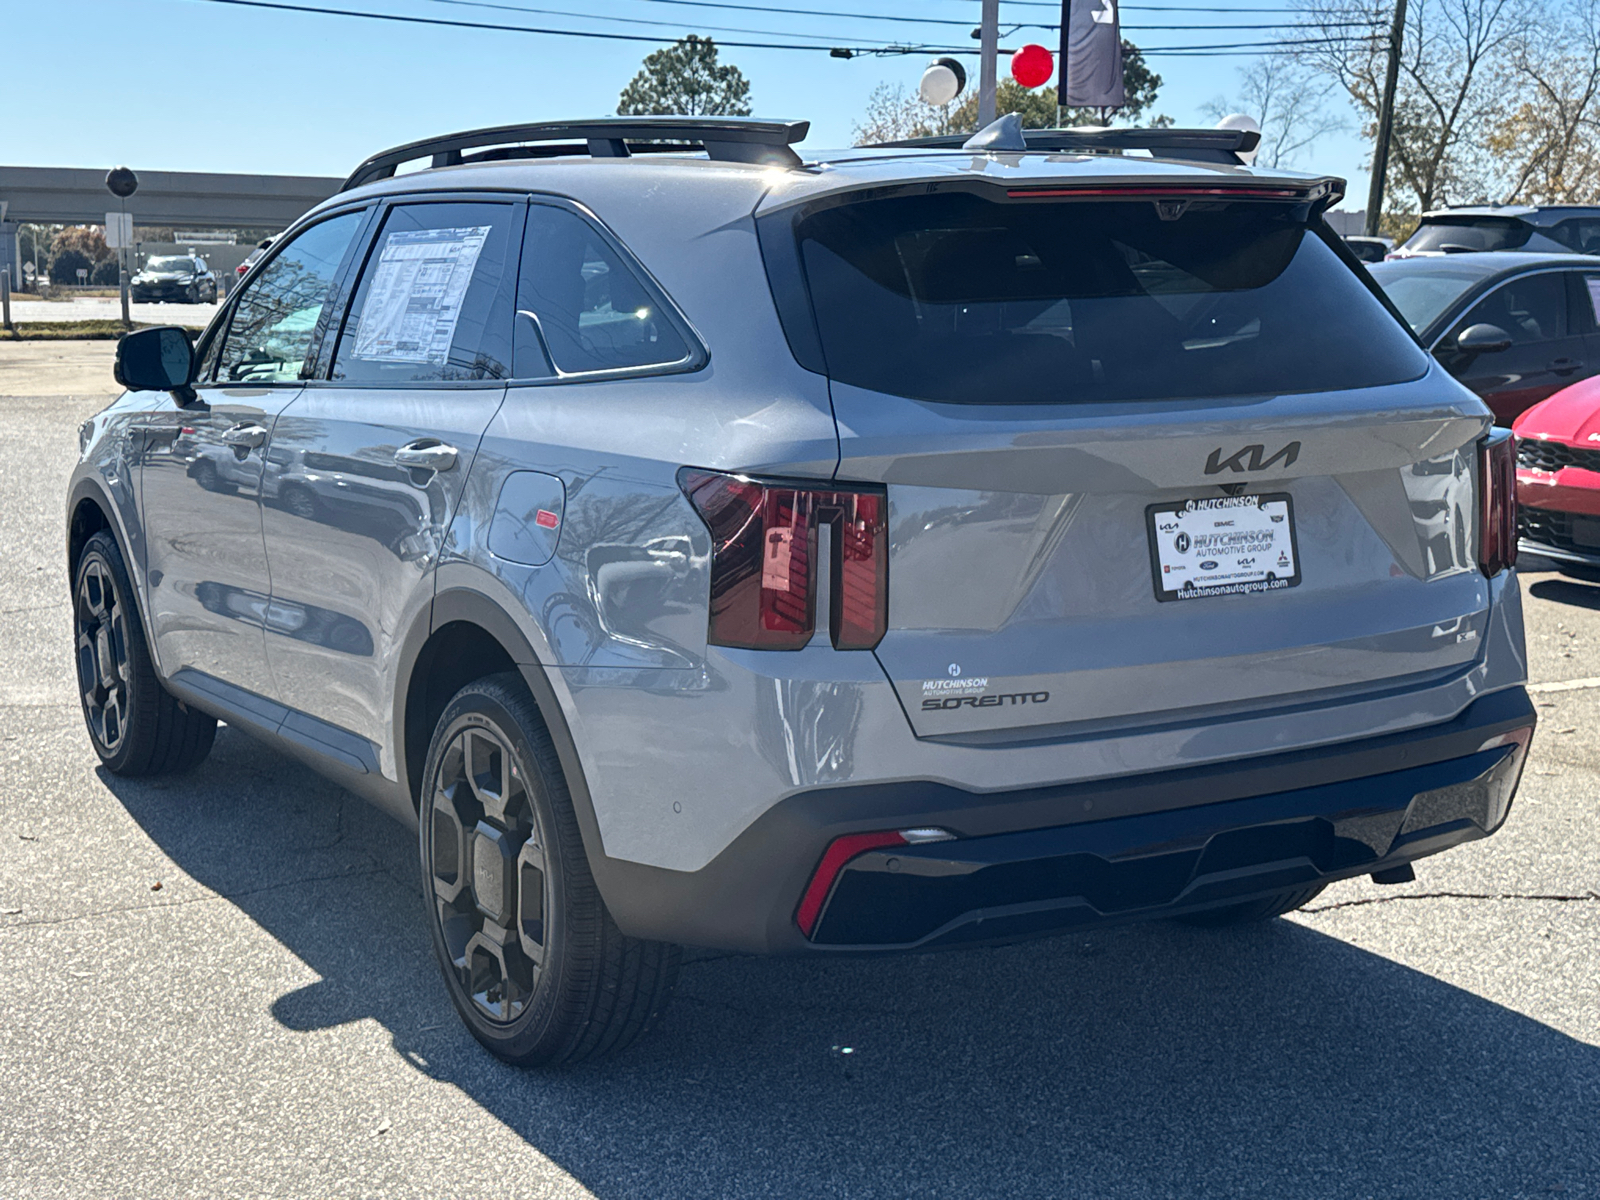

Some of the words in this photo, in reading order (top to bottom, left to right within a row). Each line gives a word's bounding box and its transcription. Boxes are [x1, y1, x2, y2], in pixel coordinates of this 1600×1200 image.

[1198, 495, 1259, 511] HUTCHINSON
[1194, 529, 1275, 548] HUTCHINSON
[1196, 547, 1245, 557] AUTOMOTIVE
[1247, 543, 1272, 552] GROUP
[1177, 578, 1288, 599] Hutchinsonautogroup.com
[922, 678, 988, 690] HUTCHINSON
[923, 688, 963, 696] AUTOMOTIVE
[921, 691, 1050, 711] SORENTO
